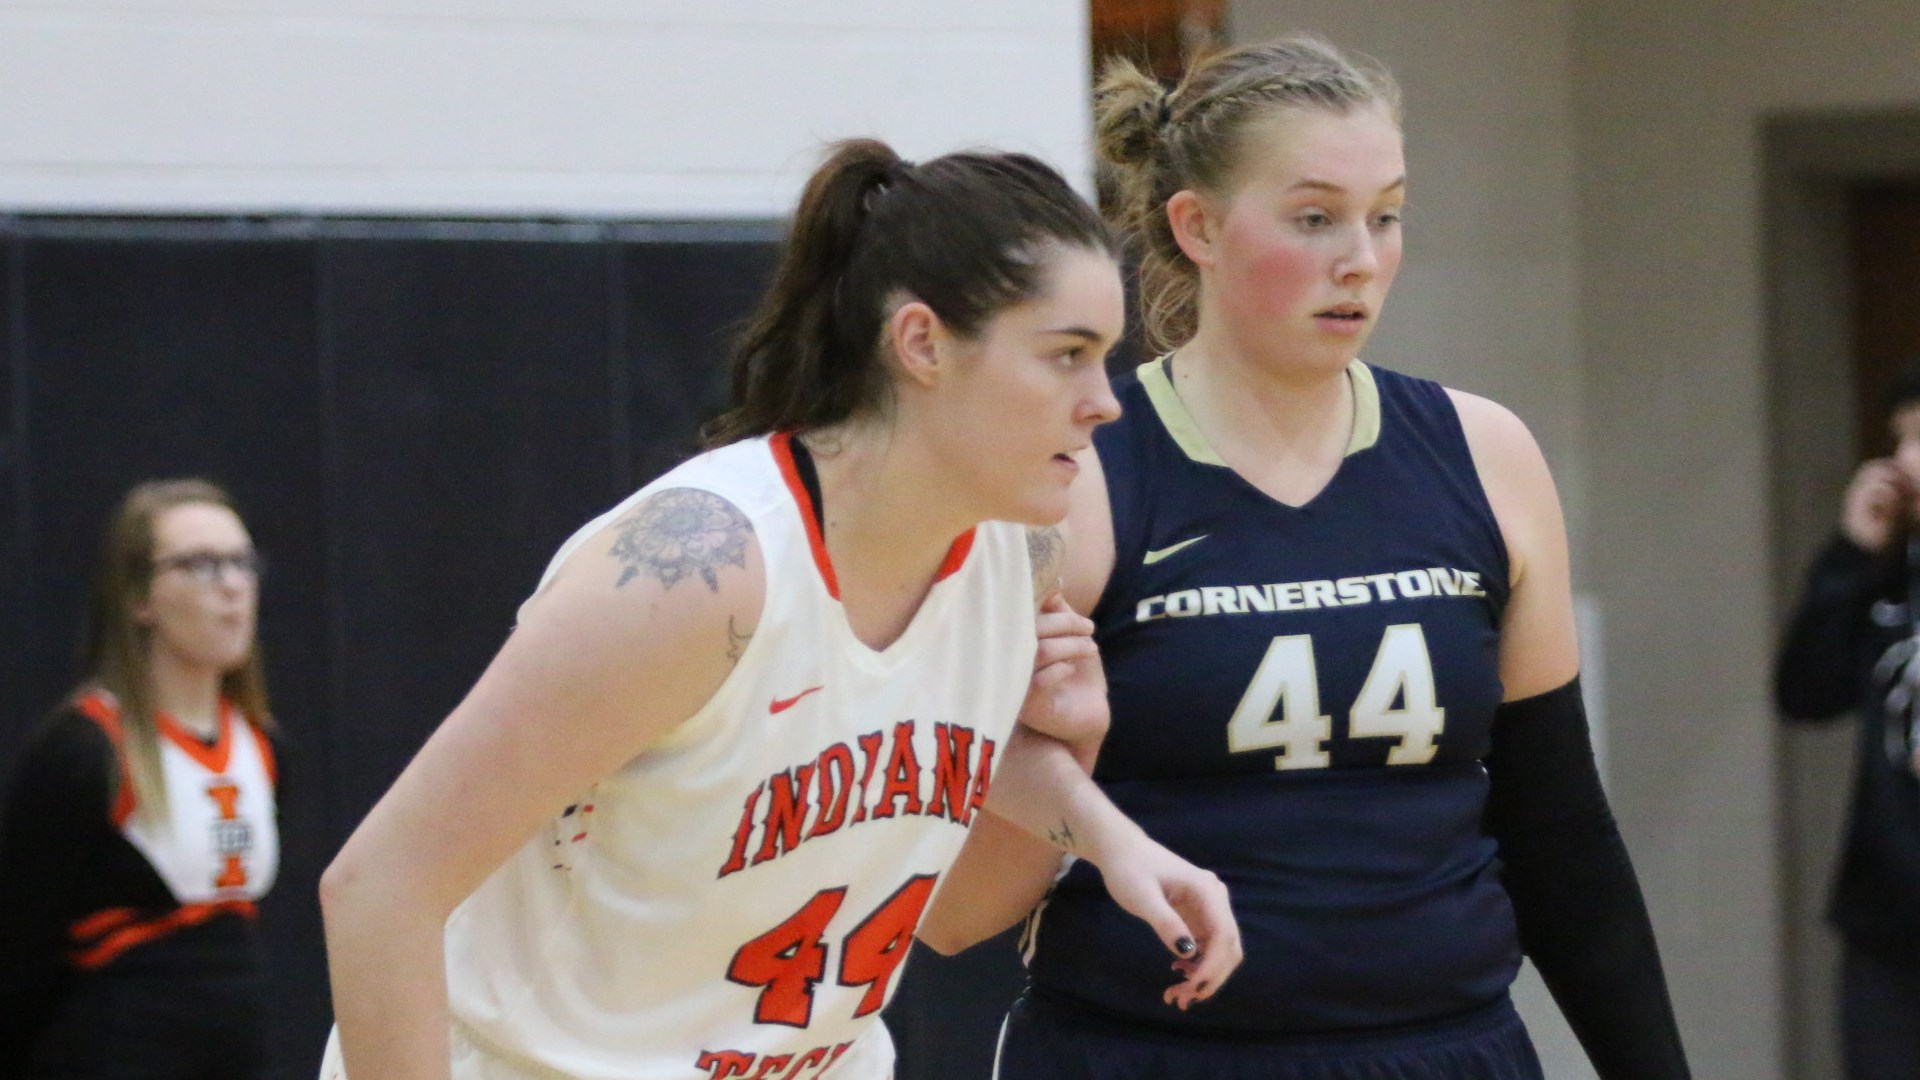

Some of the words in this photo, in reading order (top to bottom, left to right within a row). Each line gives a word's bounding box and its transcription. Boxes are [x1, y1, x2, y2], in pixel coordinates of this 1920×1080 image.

[1136, 567, 1487, 622] CORNERSTONE
[1227, 623, 1446, 771] 44
[717, 719, 996, 880] INDIANA
[724, 871, 941, 1028] 44
